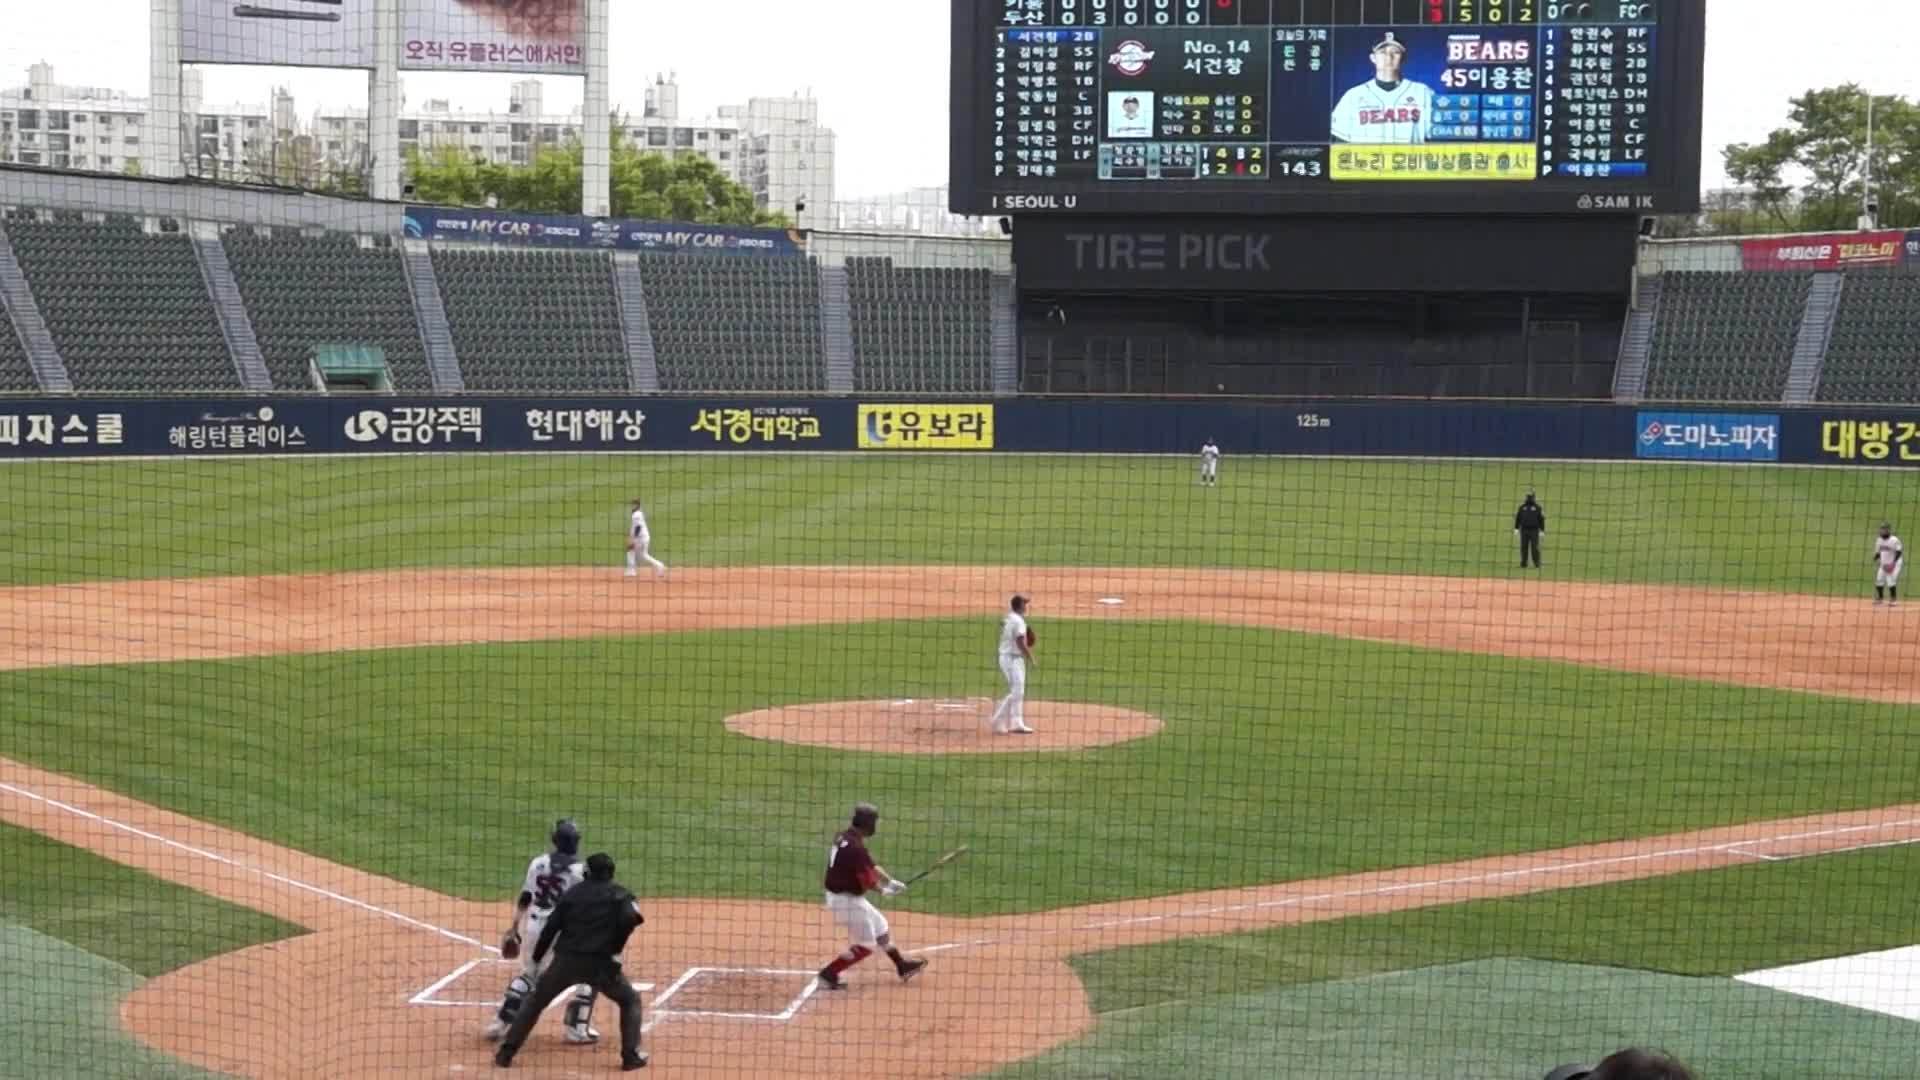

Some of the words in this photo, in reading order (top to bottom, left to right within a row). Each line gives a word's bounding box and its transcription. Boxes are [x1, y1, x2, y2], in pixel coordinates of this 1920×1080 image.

[1003, 11, 1045, 25] 두산
[1062, 11, 1075, 25] 0
[1094, 11, 1107, 24] 3
[1124, 11, 1137, 25] 0
[1155, 11, 1169, 25] 0
[1186, 11, 1200, 24] 0
[1459, 10, 1473, 22] 5
[1489, 10, 1501, 22] 0
[1520, 9, 1532, 22] 2
[1619, 5, 1639, 18] FC
[406, 40, 442, 60] 오직
[450, 42, 580, 64] 유플러스에서만
[1184, 40, 1222, 54] No.
[1227, 40, 1250, 53] 14
[1449, 41, 1529, 61] BEARS
[1184, 57, 1244, 75] 서건창
[1242, 96, 1251, 105] 0
[1624, 88, 1647, 99] DH
[1192, 111, 1201, 120] 2
[1242, 110, 1251, 119] 0
[1359, 108, 1421, 125] BEARS
[1192, 125, 1201, 134] 0
[1241, 125, 1251, 134] 0
[1624, 133, 1645, 144] CF
[1216, 148, 1227, 158] 4
[1251, 148, 1261, 158] 2
[1625, 149, 1645, 159] LF
[1216, 163, 1227, 174] 2
[1250, 164, 1261, 174] 0
[1280, 162, 1321, 176] 143
[992, 197, 998, 208] I
[1004, 196, 1059, 208] SEOUL
[1064, 196, 1076, 208] U
[1595, 196, 1629, 208] SAM
[499, 221, 530, 236] CAR
[665, 231, 690, 245] MY
[692, 233, 725, 248] CAR
[1064, 233, 1166, 269] TIRE
[1178, 233, 1272, 270] PICK
[391, 407, 482, 444] 금강주택
[526, 409, 646, 442] 현대해상
[690, 408, 821, 443] 서경대학교
[1296, 414, 1330, 427] 125m
[0, 413, 123, 445] 피자스쿨
[168, 425, 306, 448] 해링턴플레이스
[1663, 424, 1777, 450] 도미노피자
